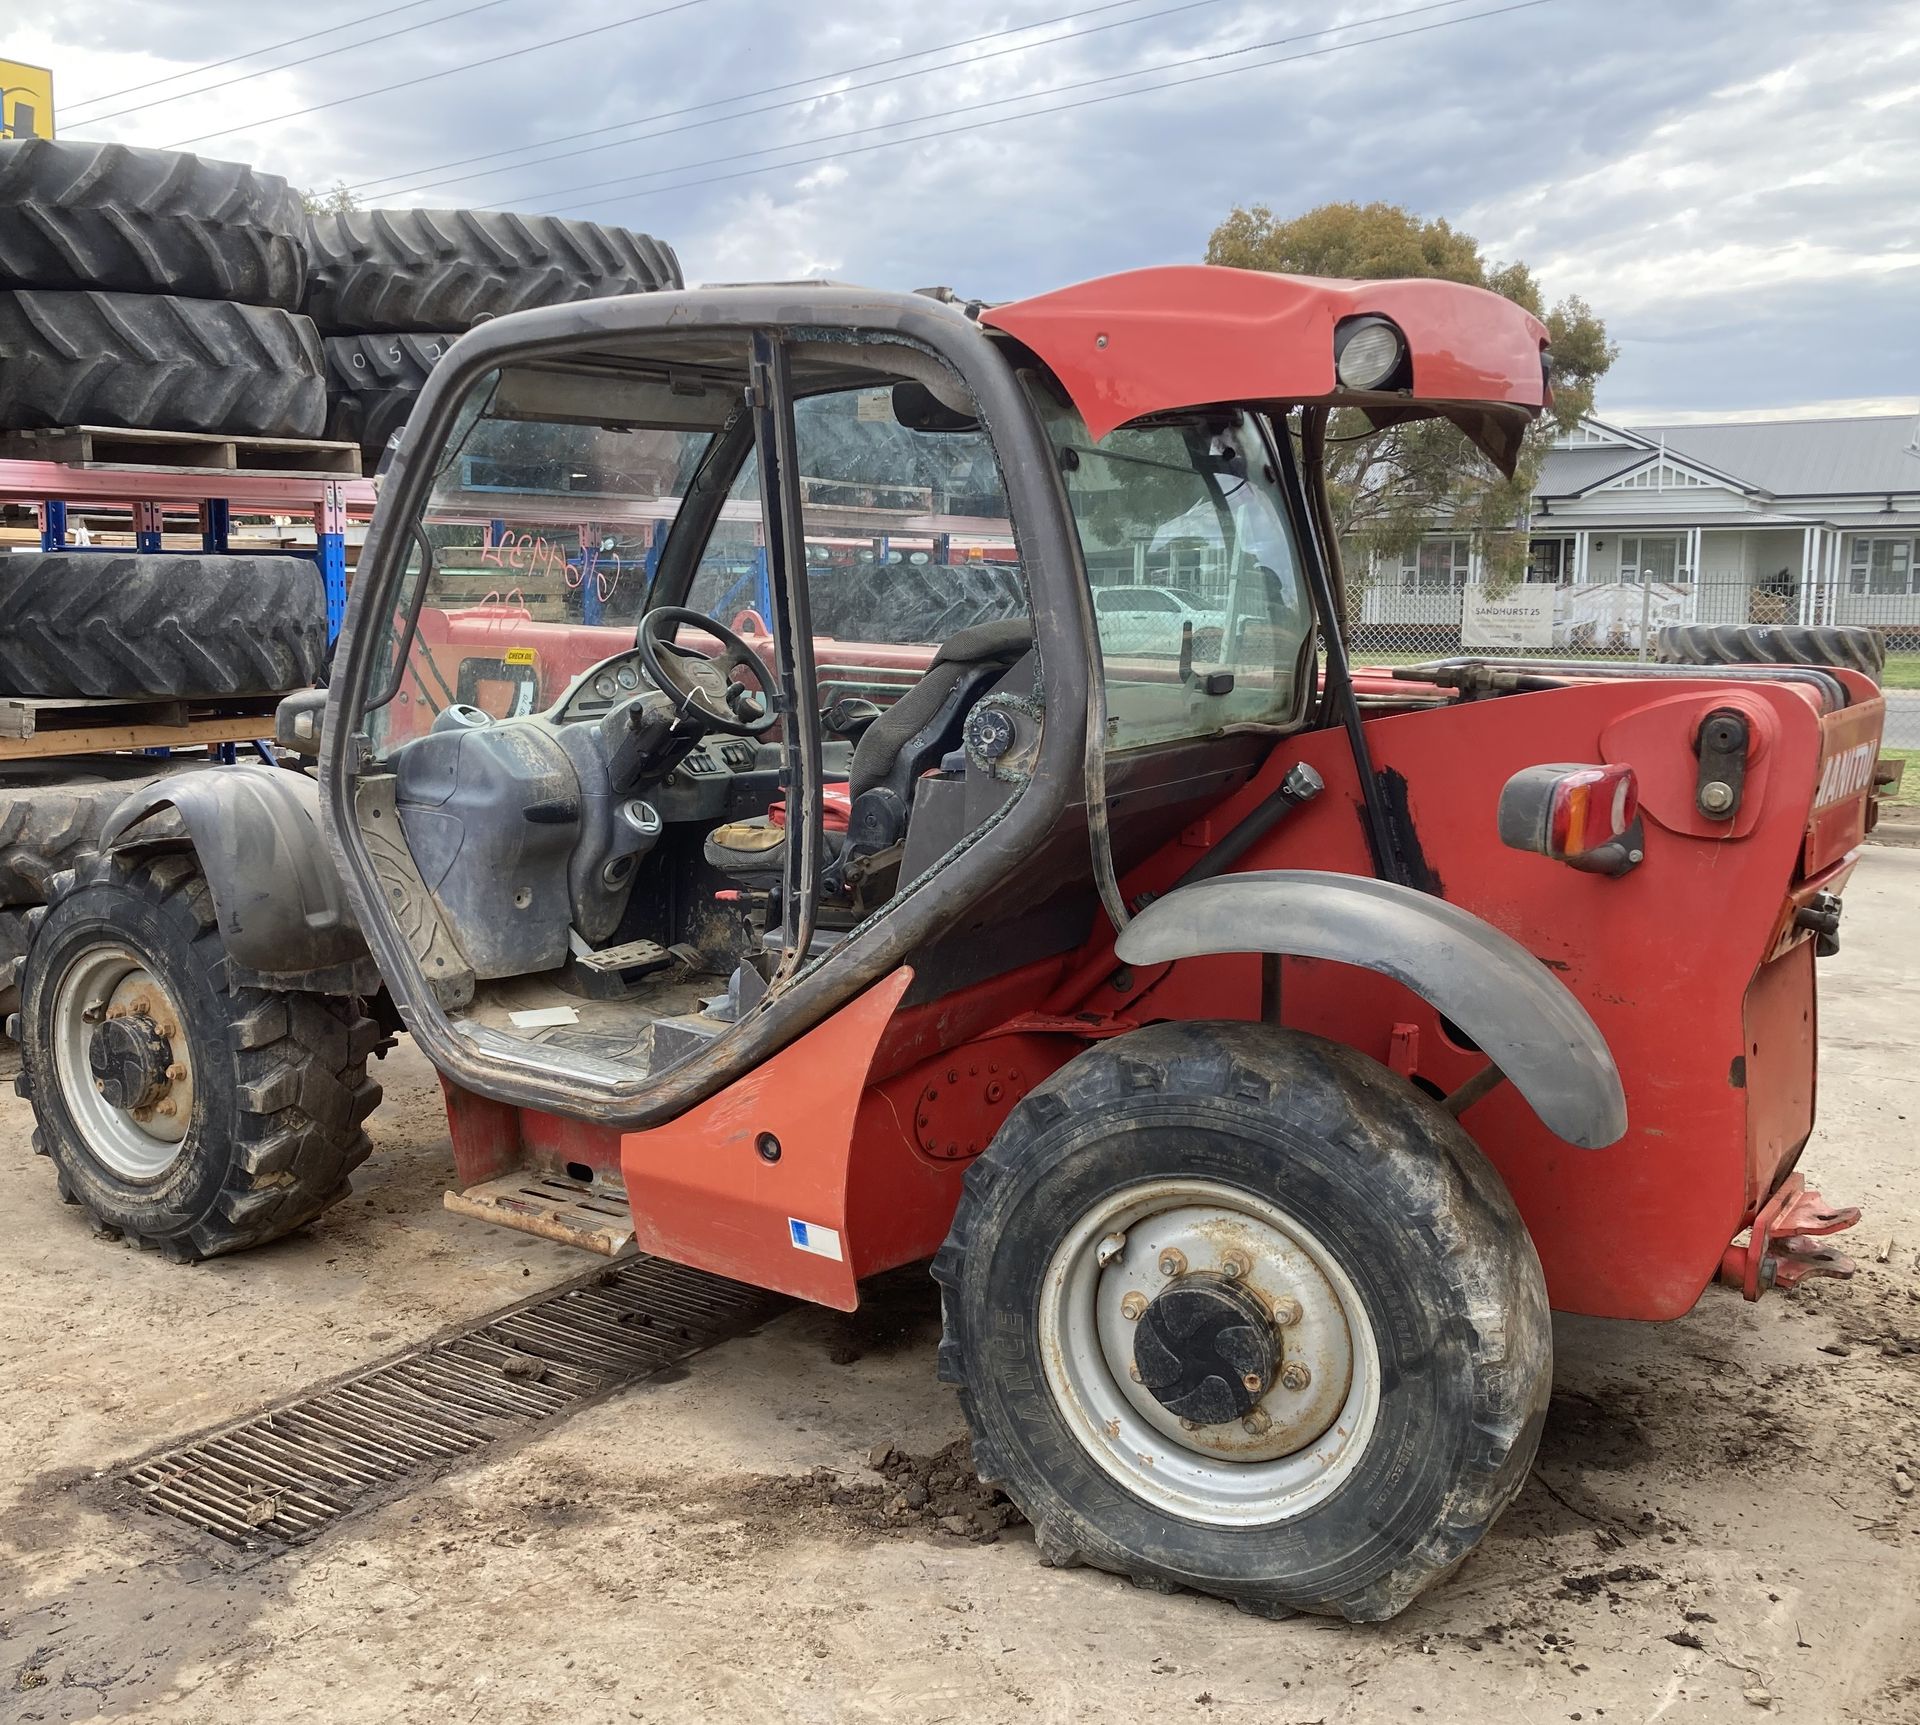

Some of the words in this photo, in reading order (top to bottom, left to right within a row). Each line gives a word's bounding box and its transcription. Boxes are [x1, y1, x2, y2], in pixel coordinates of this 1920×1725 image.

[1475, 607, 1528, 615] SANDHURST
[995, 1309, 1121, 1513] ALLIANCE
[1373, 1439, 1416, 1511] DIRECTION
